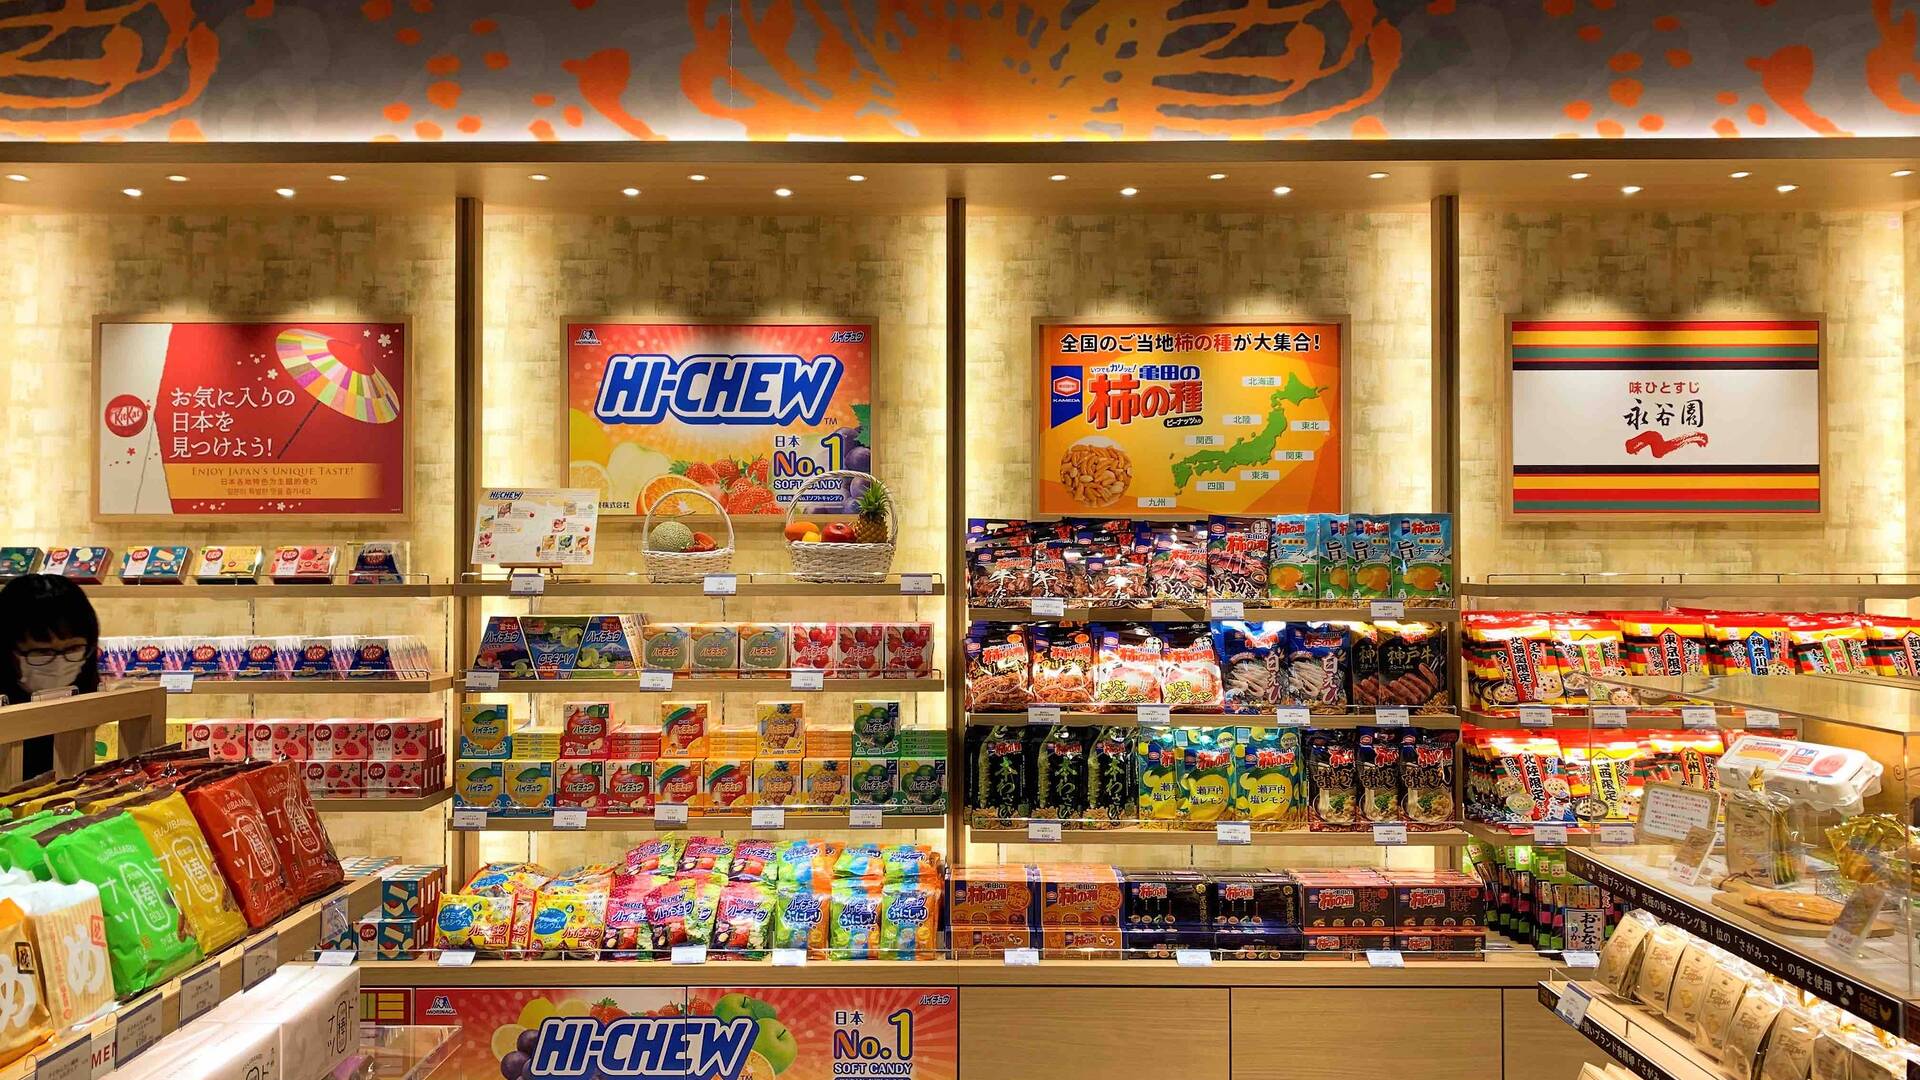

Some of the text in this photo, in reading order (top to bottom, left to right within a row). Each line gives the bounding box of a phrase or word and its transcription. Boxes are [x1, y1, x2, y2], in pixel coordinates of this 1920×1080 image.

[829, 331, 865, 343] ハイチュウ
[1139, 365, 1200, 380] 亀田の
[1248, 377, 1275, 386] 北海道
[593, 354, 845, 426] HI-CHEW
[1629, 381, 1700, 395] 味ひとすじ
[170, 386, 296, 408] お気に入りの
[1087, 374, 1203, 429] 柿の種
[1232, 415, 1251, 425] 北陸
[1623, 398, 1704, 430] 永谷園
[173, 411, 234, 433] 日本を
[1301, 421, 1320, 431] 東北
[775, 436, 800, 448] 日本
[1195, 435, 1213, 445] 関西
[774, 433, 845, 478] No.1
[1285, 451, 1304, 460] 関東
[192, 467, 223, 476] ENJOY
[272, 467, 312, 477] UNIQUE
[1251, 470, 1269, 480] 東海
[774, 479, 803, 490] SOFT
[1207, 481, 1225, 491] 四国
[1148, 498, 1166, 507] 九州
[1388, 646, 1435, 664] 神戸牛
[1510, 636, 1531, 683] 北海道限定
[573, 725, 601, 734] ハイチュウ
[566, 783, 595, 792] ハイチュウ
[615, 783, 644, 792] ハイチュウ
[1257, 785, 1286, 795] 瀬戸内
[919, 994, 951, 1006] ハイチュウ
[835, 1011, 864, 1026] 日本
[833, 1008, 914, 1061] No.1
[530, 1016, 760, 1080] HI-CHEW
[833, 1062, 913, 1075] SOFT CANDY
